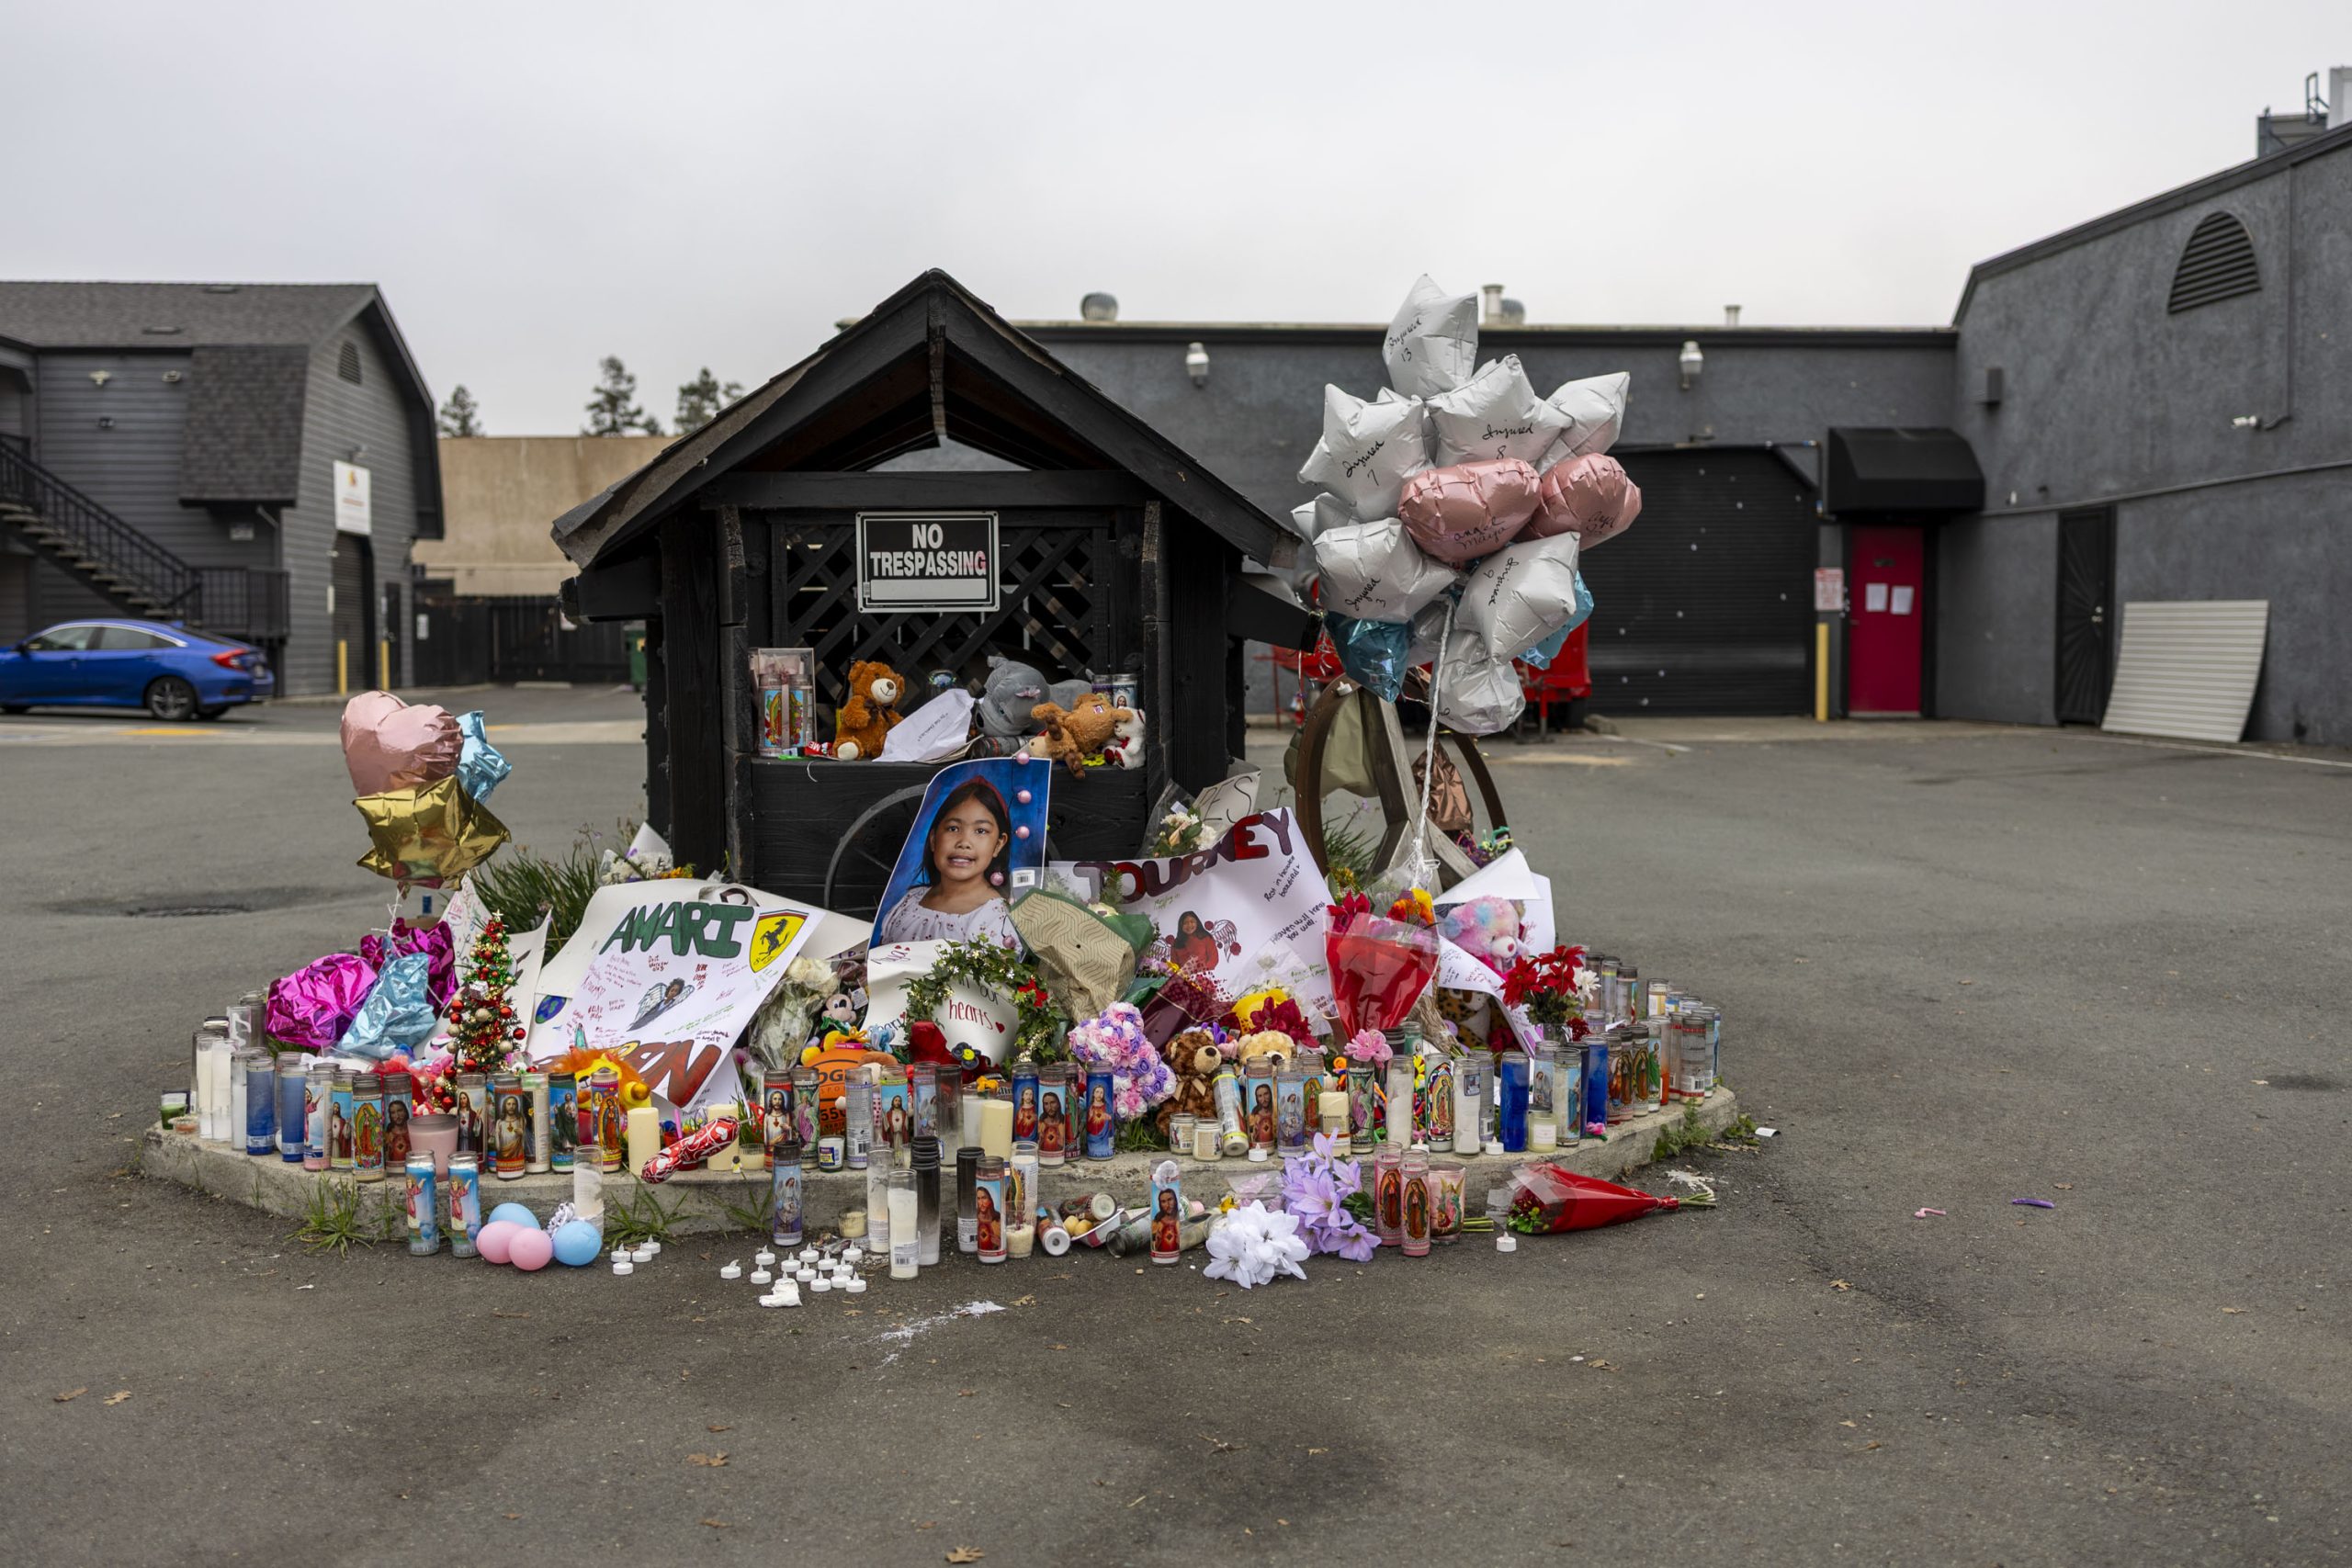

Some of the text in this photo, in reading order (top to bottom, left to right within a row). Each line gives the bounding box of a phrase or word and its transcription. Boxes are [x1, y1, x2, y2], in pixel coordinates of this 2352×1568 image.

[1401, 347, 1412, 362] 13
[1481, 422, 1534, 442] Injured
[1341, 440, 1385, 478] Injured
[1496, 445, 1507, 459] 8
[911, 523, 944, 549] NO
[869, 549, 987, 577] TRESPASSING
[1345, 575, 1382, 611] Injured
[599, 901, 754, 958] AMARI
[949, 999, 993, 1031] hearts
